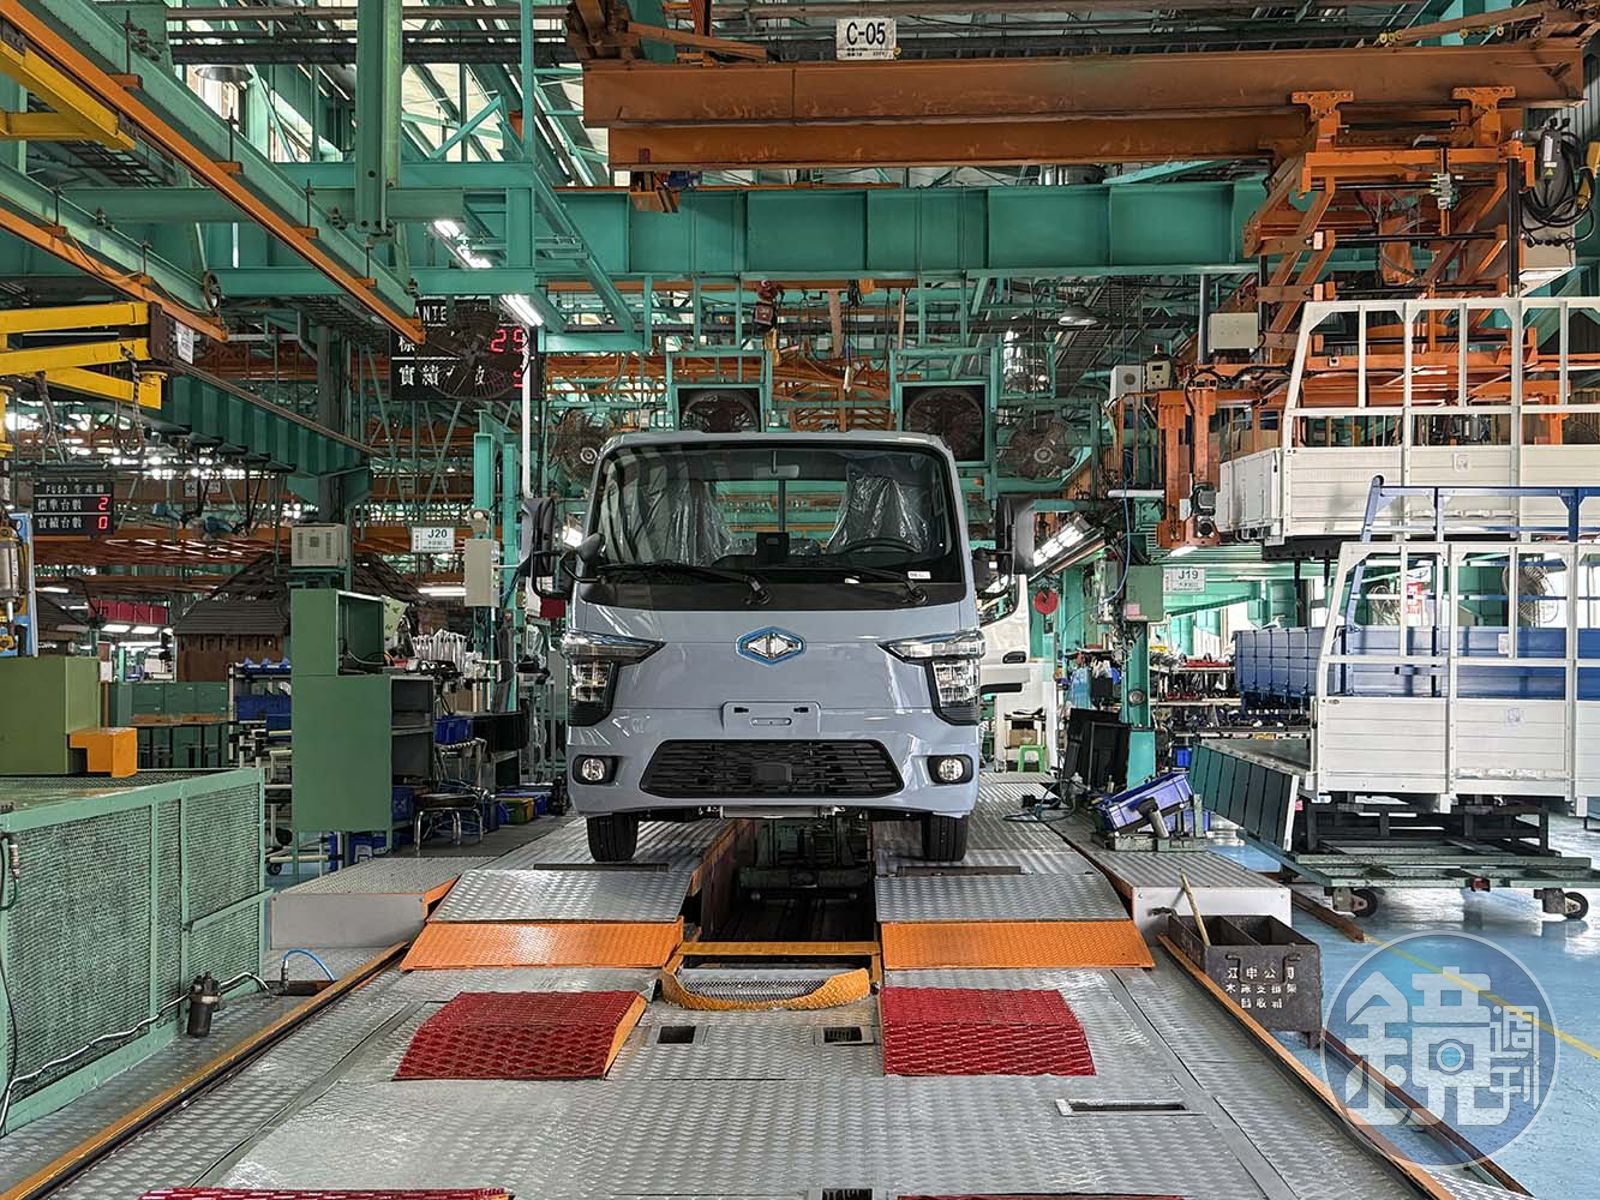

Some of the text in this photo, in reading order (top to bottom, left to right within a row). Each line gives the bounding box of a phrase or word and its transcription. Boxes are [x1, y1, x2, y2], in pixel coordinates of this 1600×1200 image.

[846, 22, 886, 45] C-05
[45, 484, 68, 494] FUSO
[98, 497, 109, 511] 2
[98, 516, 108, 529] 0
[427, 529, 448, 539] J20
[1178, 570, 1199, 580] J19
